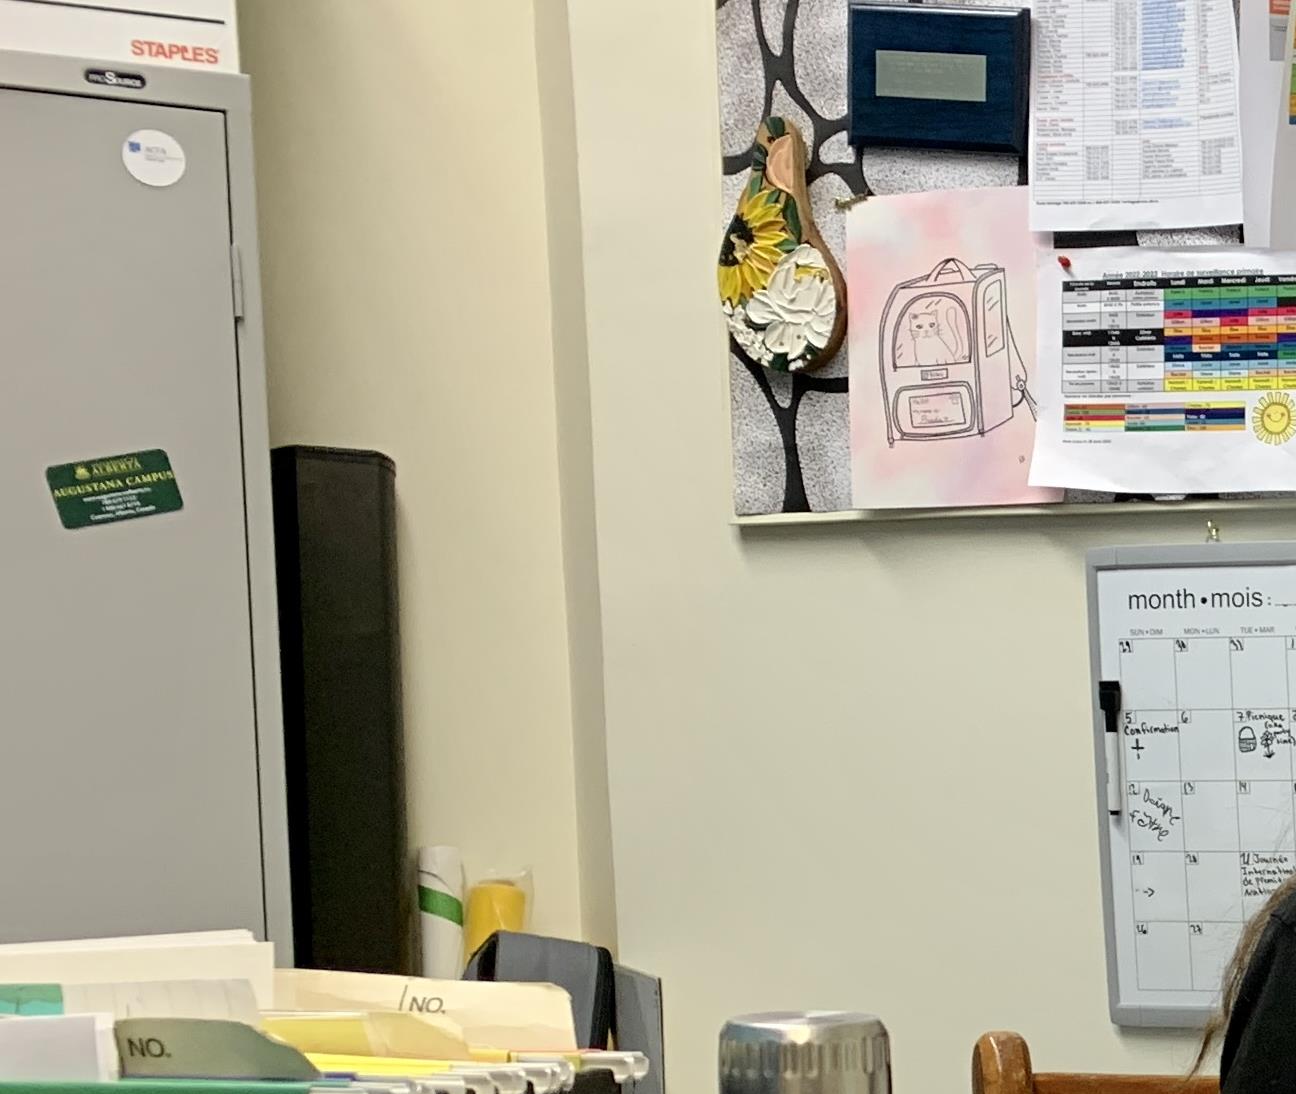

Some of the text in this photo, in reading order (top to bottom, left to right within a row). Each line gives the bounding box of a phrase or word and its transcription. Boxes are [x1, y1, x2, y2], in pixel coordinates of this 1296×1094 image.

[131, 39, 219, 65] STAPLES
[53, 470, 175, 497] AUGUSTANA CAMPUS
[1128, 588, 1196, 610] month
[1125, 712, 1133, 723] 5
[1180, 711, 1188, 723] 6
[1124, 722, 1180, 737] Confirmation
[408, 996, 447, 1015] NO.
[127, 1037, 171, 1058] NO.
